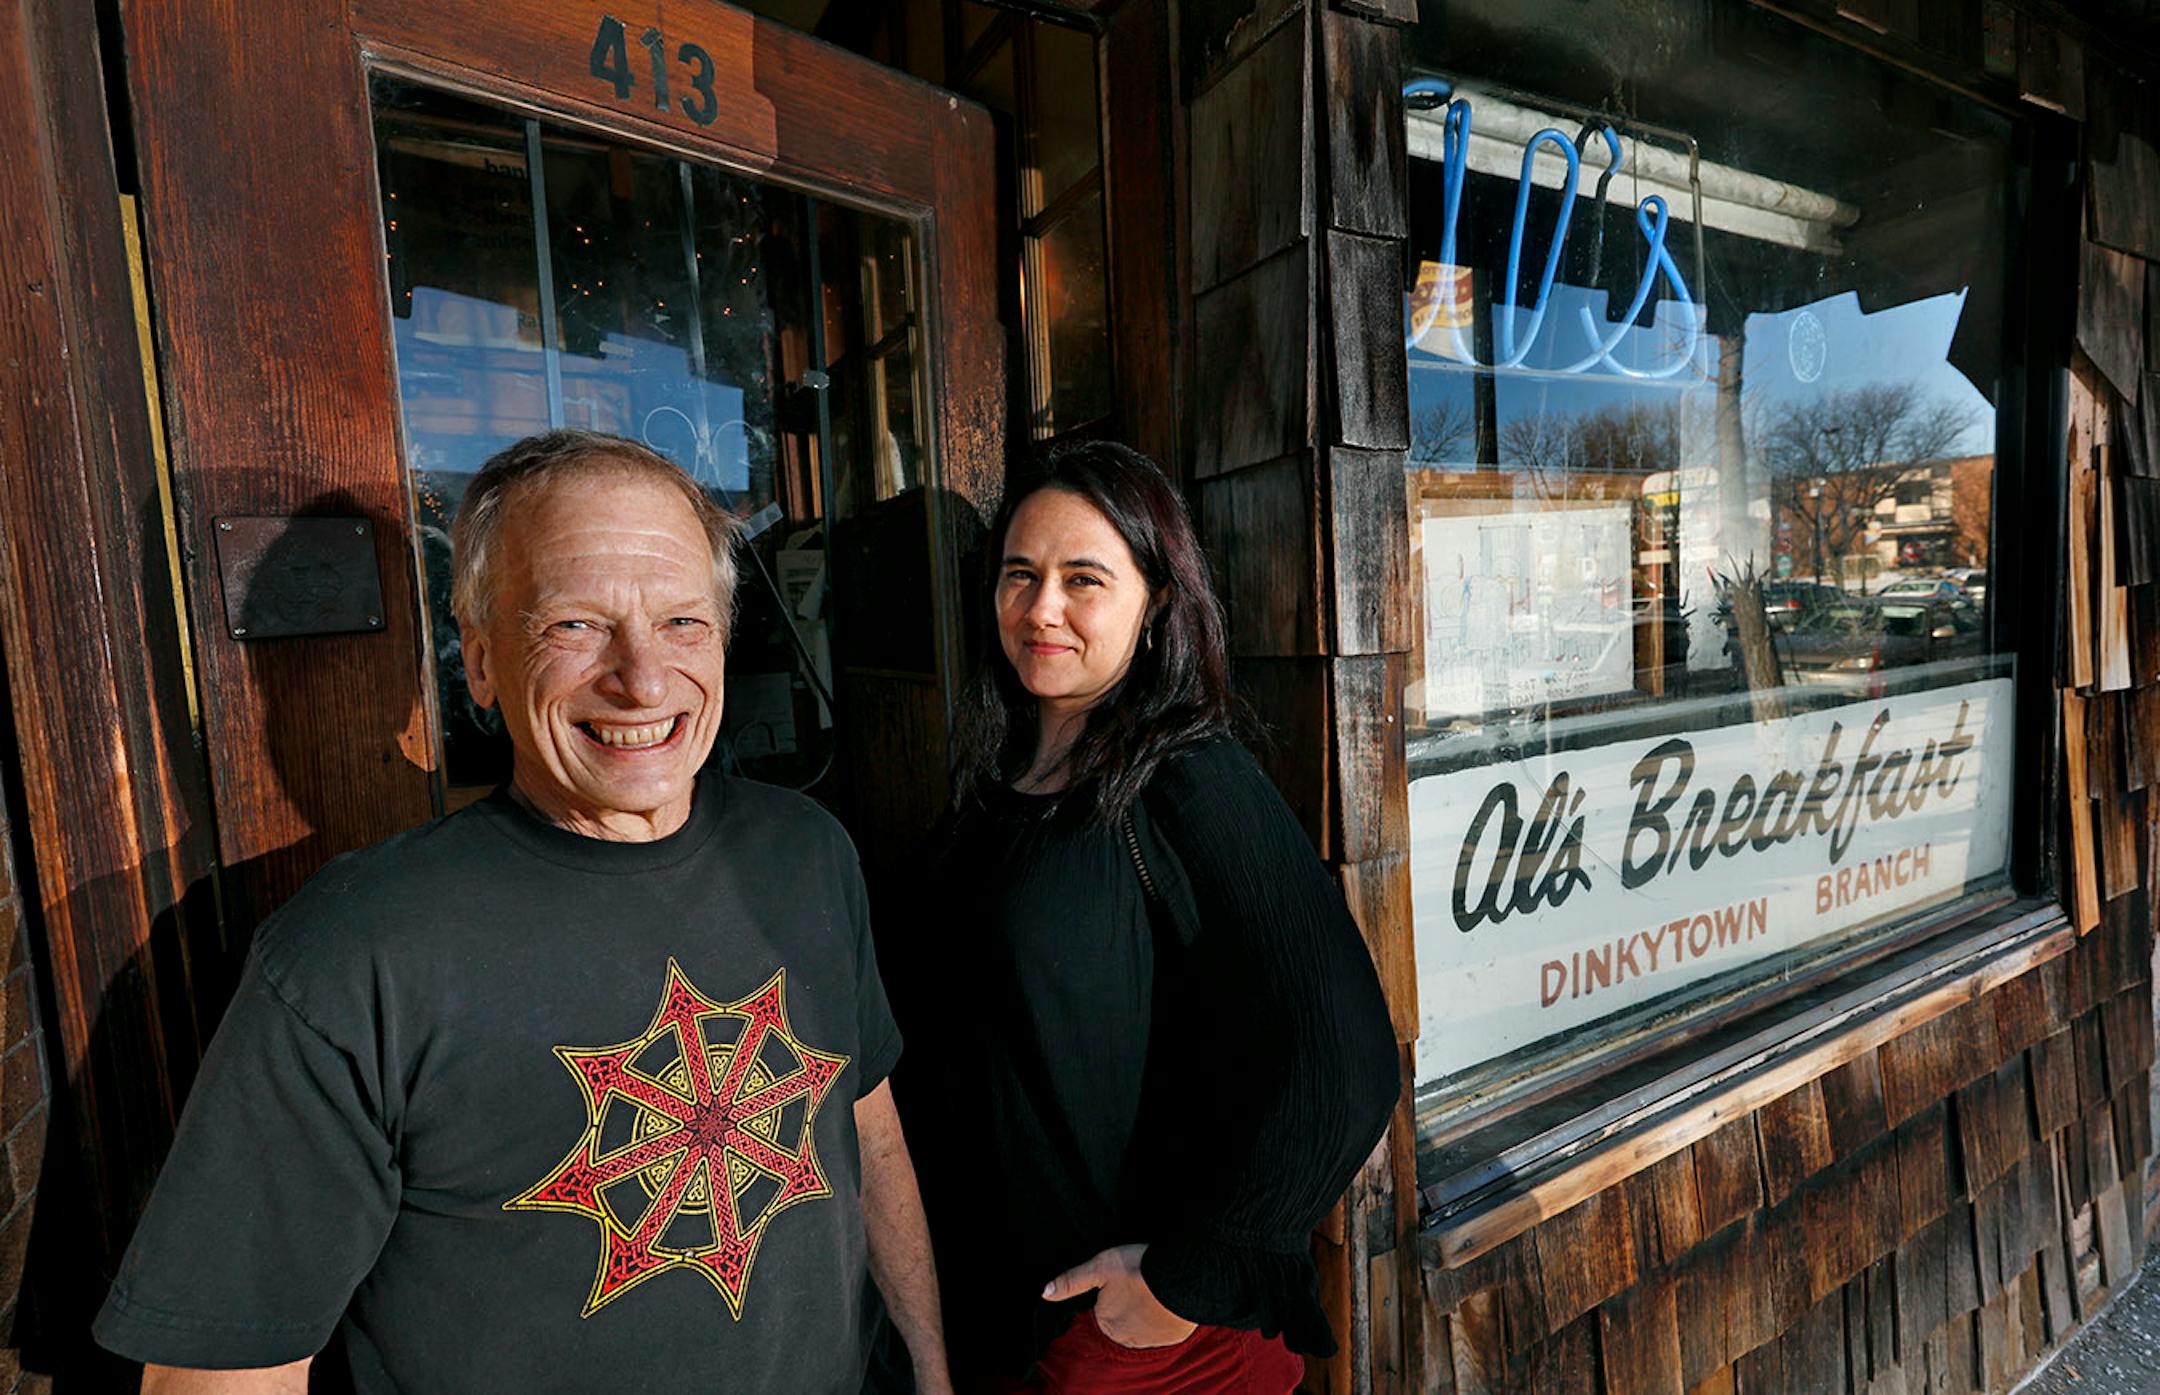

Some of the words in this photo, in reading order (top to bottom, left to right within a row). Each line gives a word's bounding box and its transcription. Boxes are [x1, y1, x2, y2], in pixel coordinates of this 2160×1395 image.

[589, 13, 718, 126] 413
[1453, 771, 1592, 933] Al's
[1621, 699, 1974, 890] Breakfast
[1541, 898, 1767, 1008] DINKYTOWN
[1816, 843, 1930, 915] BRANCH
